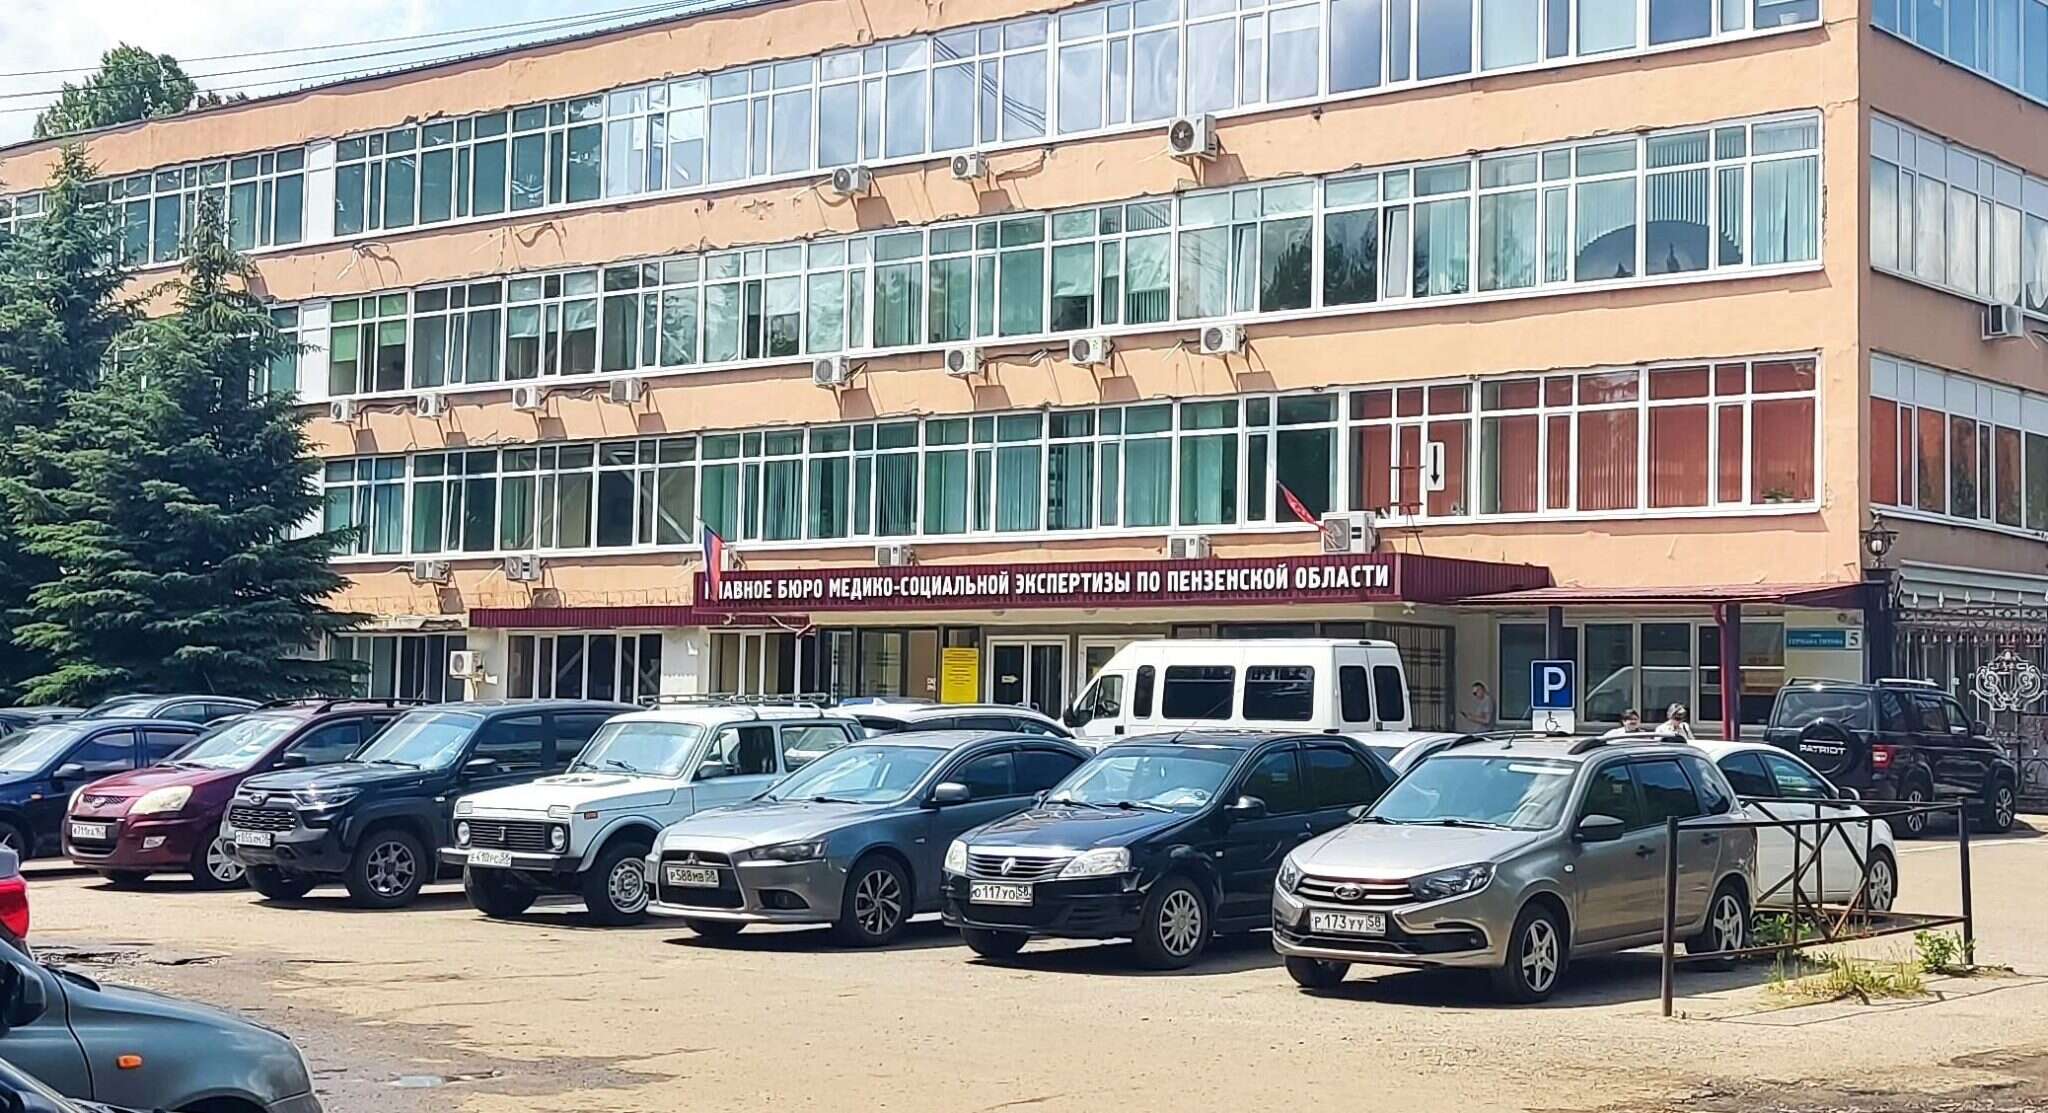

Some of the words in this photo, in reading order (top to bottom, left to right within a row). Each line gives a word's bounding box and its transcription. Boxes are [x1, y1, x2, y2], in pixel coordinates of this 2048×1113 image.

[777, 578, 823, 599] БЮРО
[829, 571, 1009, 600] МЕДИКО-СОЦИАЛЬНОЙ
[1015, 571, 1131, 594] ЭКСПЕРТИЗЫ
[1136, 570, 1161, 593] ПО
[1167, 563, 1288, 592] ПЕНЗЕНСКОЙ
[1295, 564, 1389, 589] ОБЛАСТИ
[1849, 632, 1859, 646] 5
[1543, 666, 1567, 704] P
[1799, 744, 1847, 756] PATRIOT
